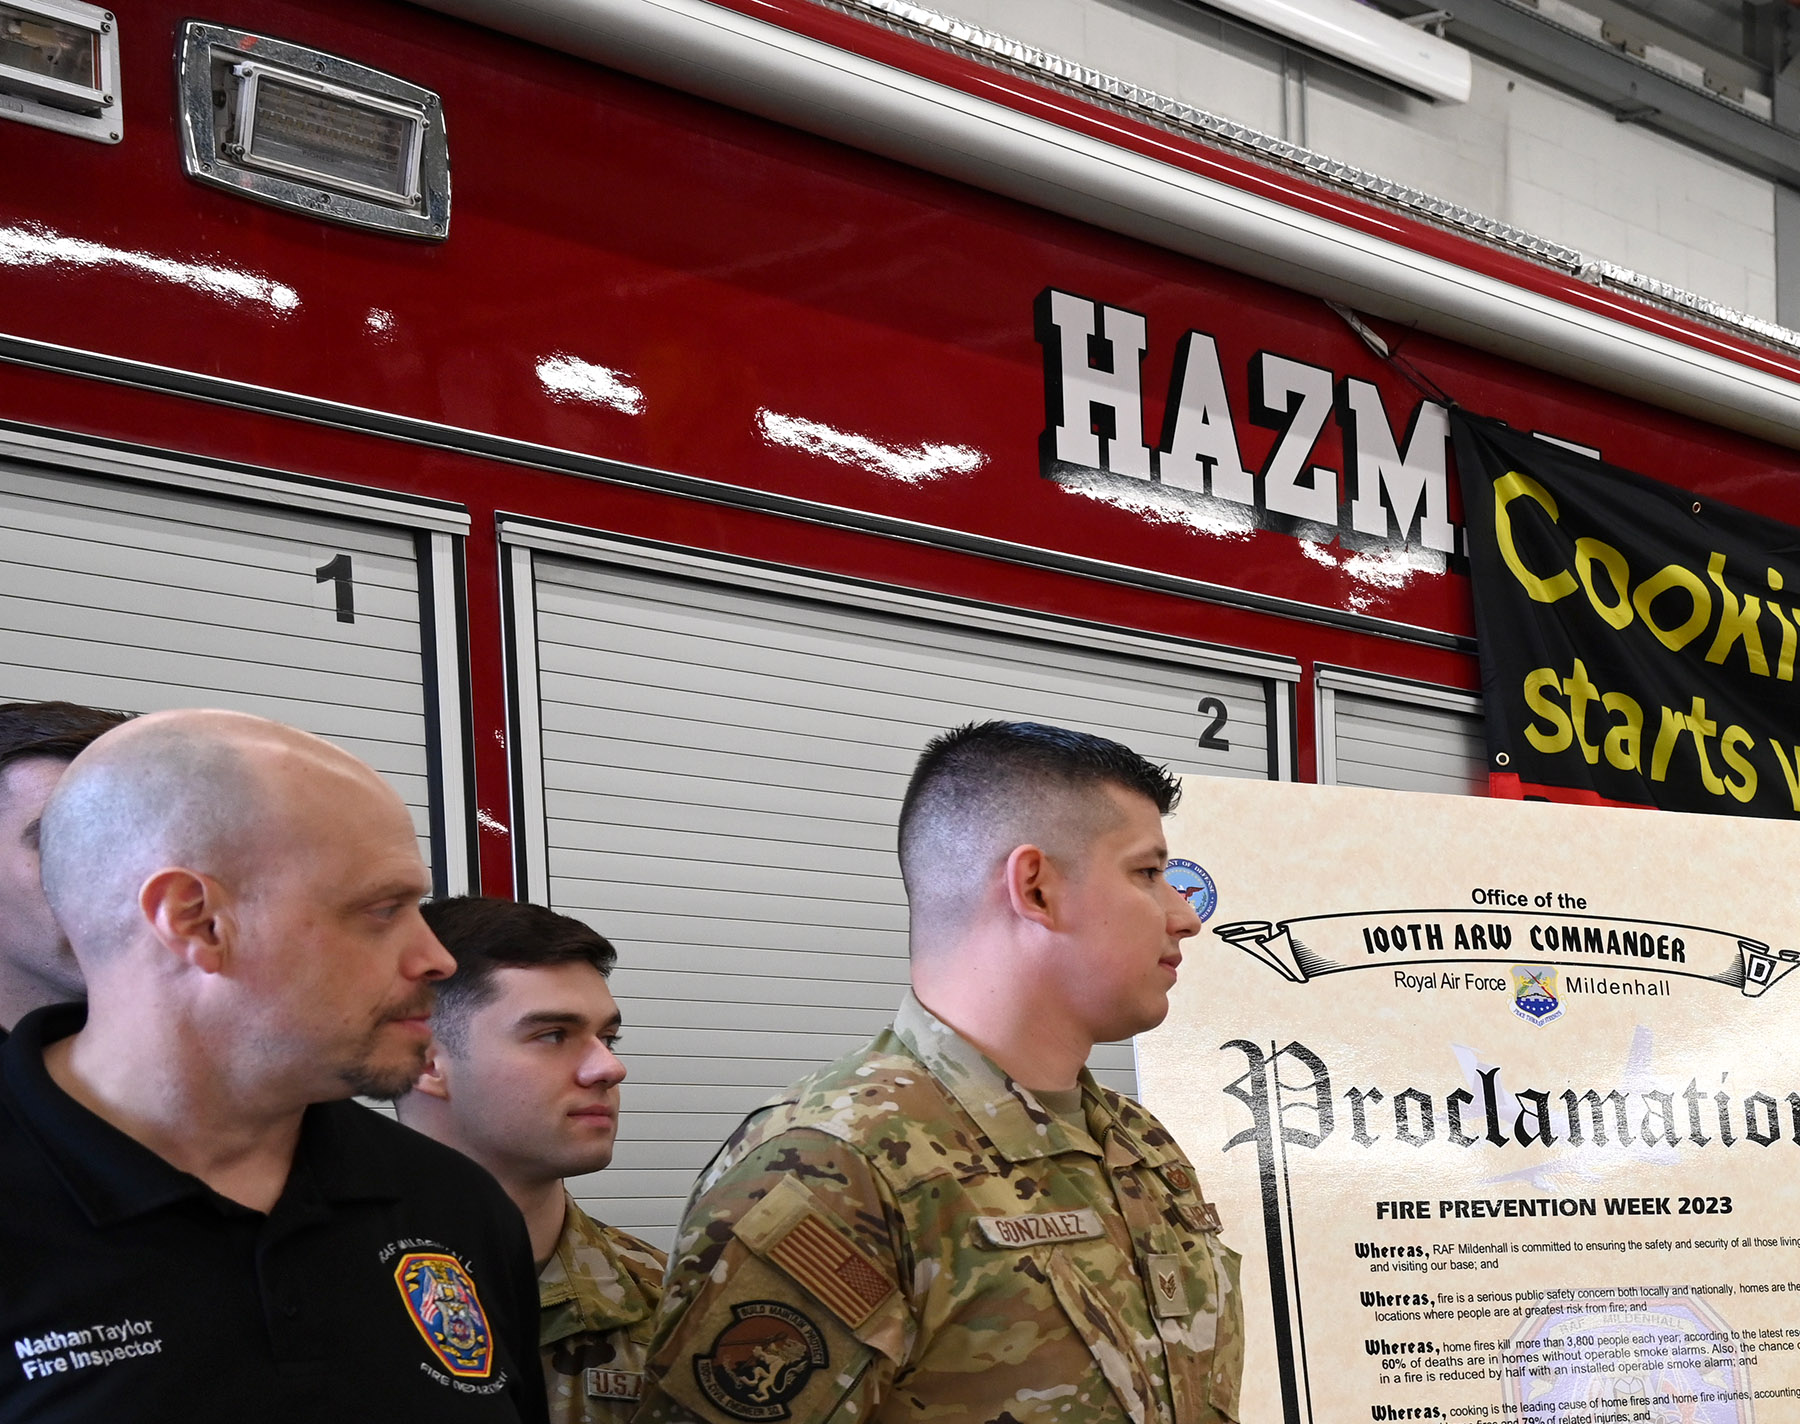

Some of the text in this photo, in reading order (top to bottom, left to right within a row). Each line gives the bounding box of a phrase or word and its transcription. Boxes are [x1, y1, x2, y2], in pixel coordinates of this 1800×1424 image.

[1042, 287, 1468, 558] HAZM
[316, 554, 354, 624] 1
[1198, 697, 1229, 751] 2
[1523, 657, 1758, 804] starts
[1194, 866, 1215, 893] DEFENSE
[1470, 887, 1588, 911] Office of the
[1361, 922, 1687, 965] 100TH ARW COMMANDER
[1393, 969, 1671, 997] Royal Air Force Mildenhall
[1375, 1195, 1734, 1221] FIRE PREVENTION WEEK 2023
[995, 1213, 1088, 1244] GONZALEZ
[1353, 1241, 1431, 1261] Whereas,
[1431, 1242, 1456, 1256] RAF
[1457, 1241, 1510, 1255] Mildenhall
[1509, 1241, 1521, 1254] is
[1520, 1240, 1573, 1254] committed
[1572, 1240, 1585, 1253] to
[1584, 1238, 1627, 1254] ensuring
[1626, 1238, 1644, 1251] the
[1643, 1238, 1674, 1253] safety
[1673, 1237, 1693, 1250] and
[1693, 1237, 1730, 1252] security
[1729, 1236, 1740, 1249] of
[1740, 1236, 1753, 1249] all
[1752, 1236, 1779, 1248] those
[1369, 1257, 1500, 1275] and visiting our base; and
[1373, 1300, 1649, 1323] locations where people are at greatest risk from fire; and
[1559, 1312, 1684, 1334] RAF MILDENHALL
[14, 1319, 153, 1359] Nathan Taylor
[22, 1339, 163, 1381] Fire Inspector
[420, 1362, 450, 1386] FIRE
[1632, 1409, 1652, 1423] and
